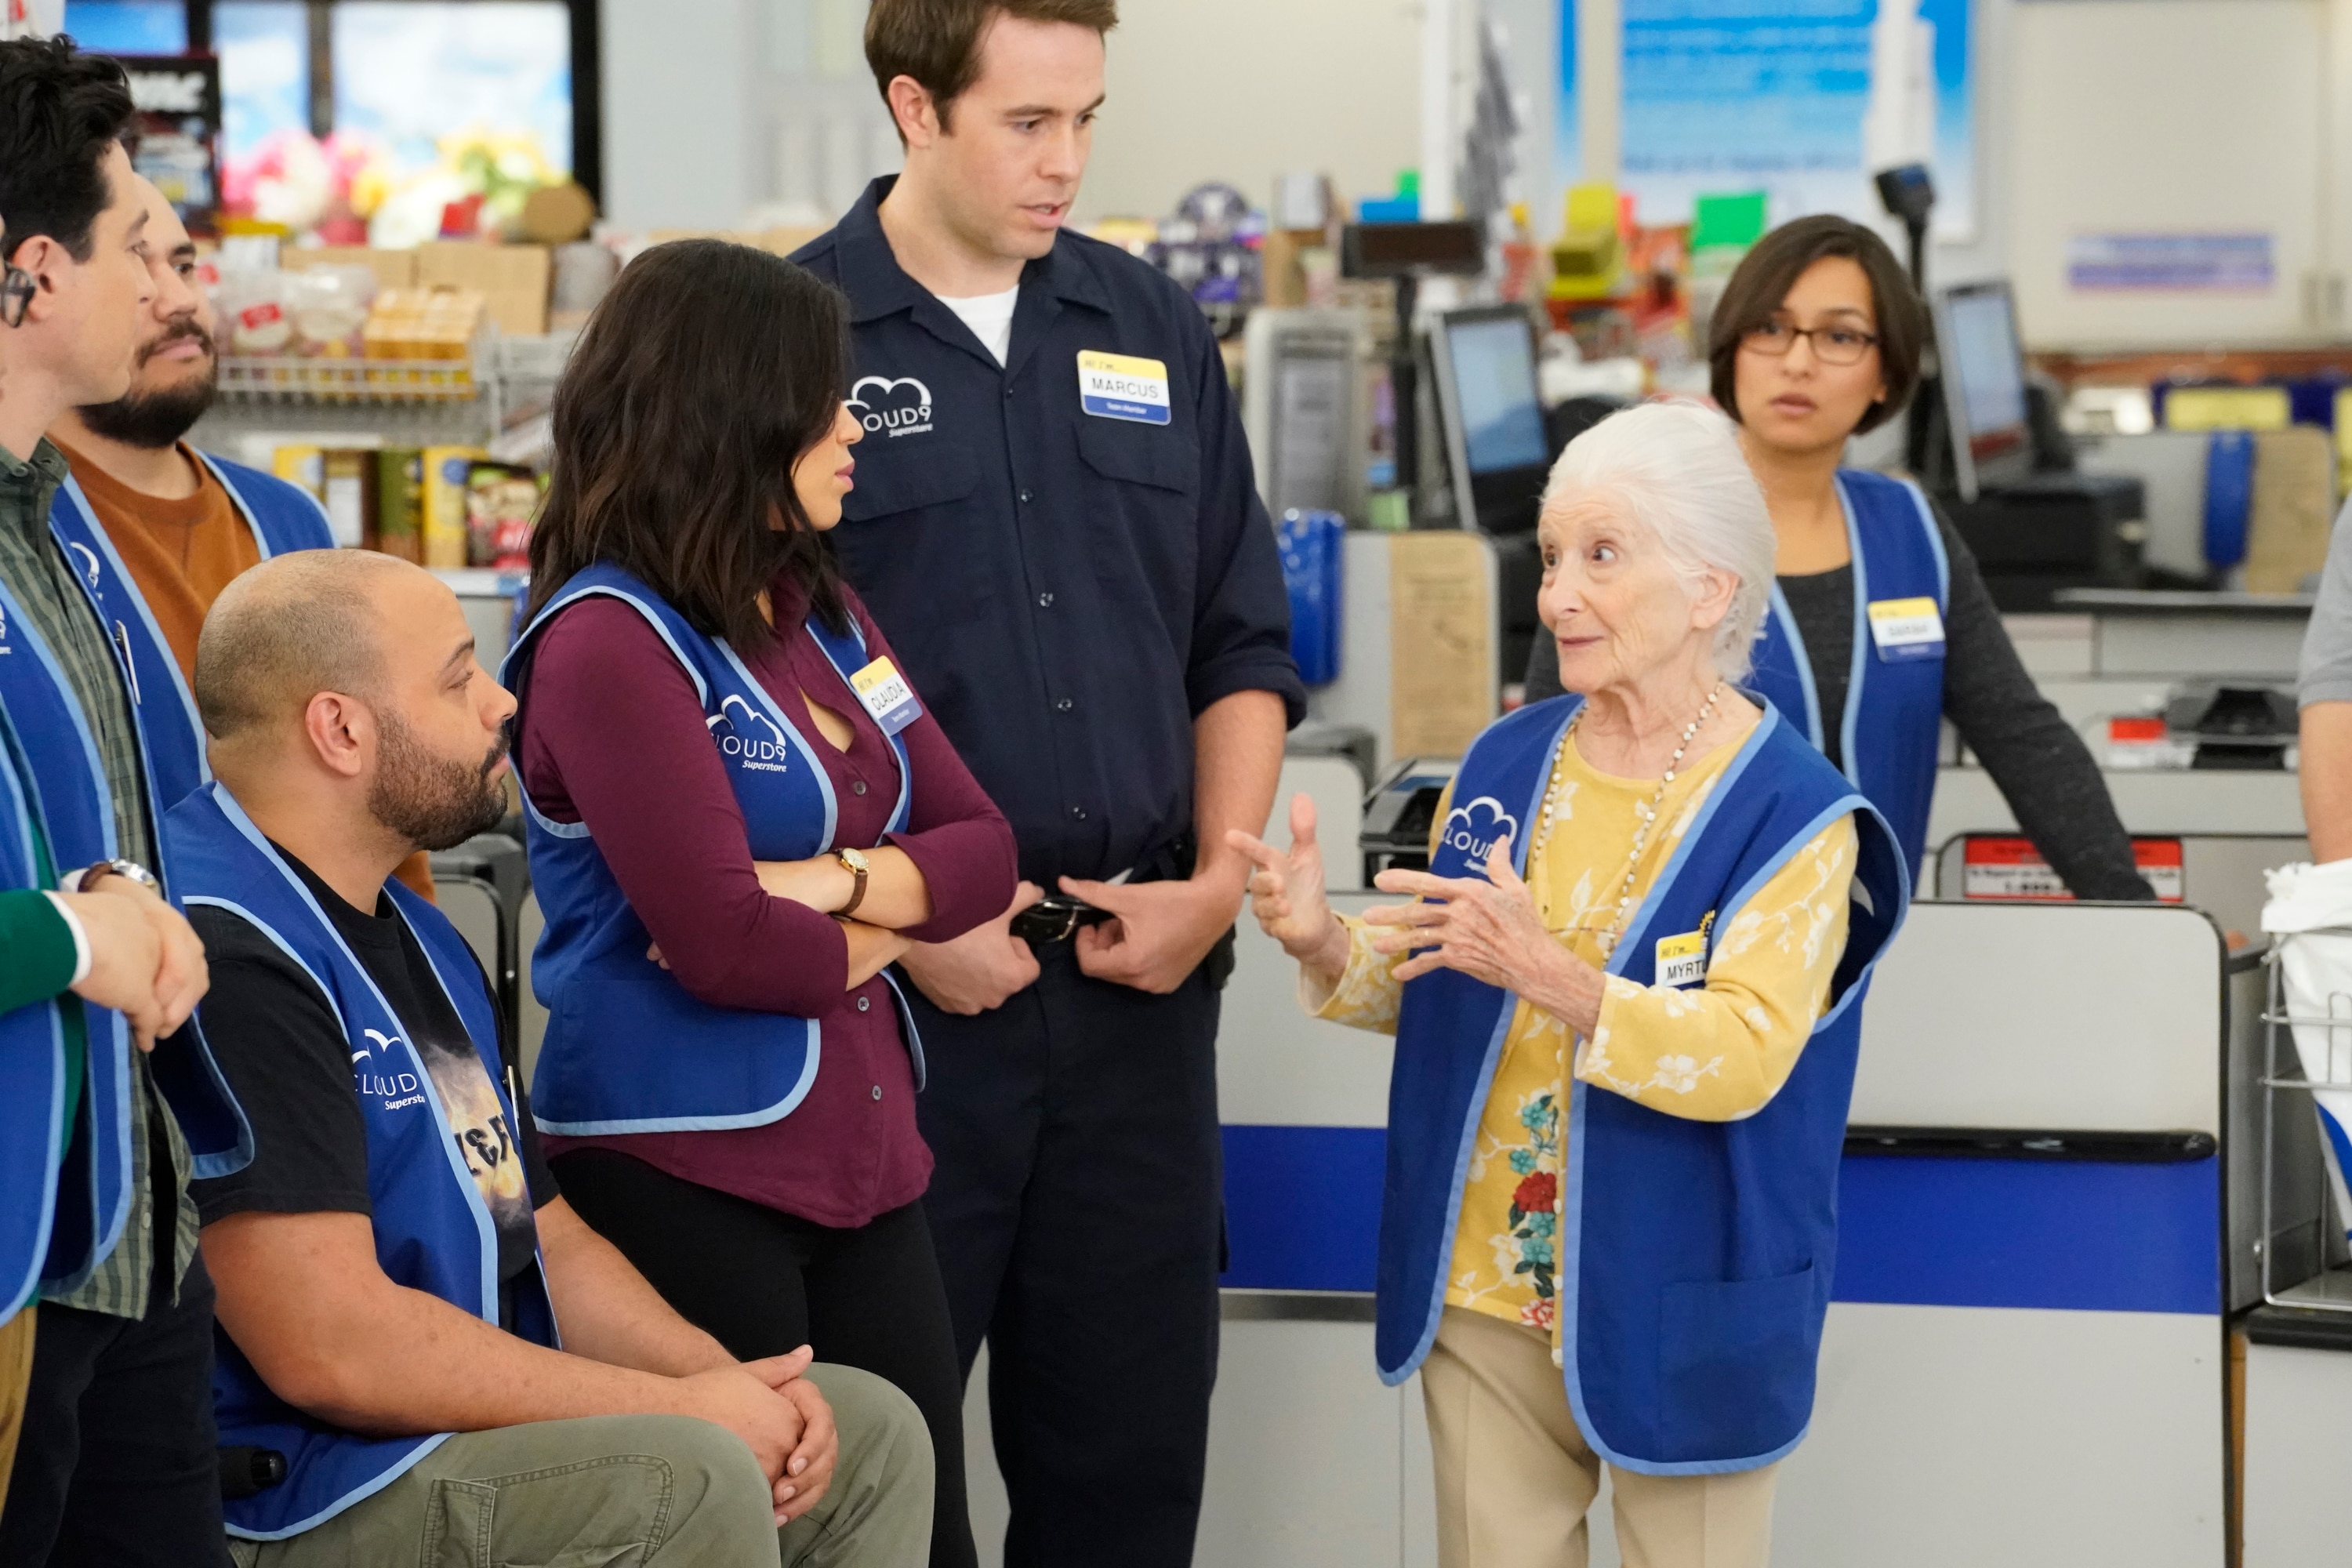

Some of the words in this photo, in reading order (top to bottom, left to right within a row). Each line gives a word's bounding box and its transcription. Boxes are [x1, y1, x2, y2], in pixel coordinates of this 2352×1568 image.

[1091, 377, 1160, 399] MARCUS
[871, 681, 906, 711] CLAUDIA
[711, 732, 786, 762] LOUD9
[742, 759, 786, 772] Superstore
